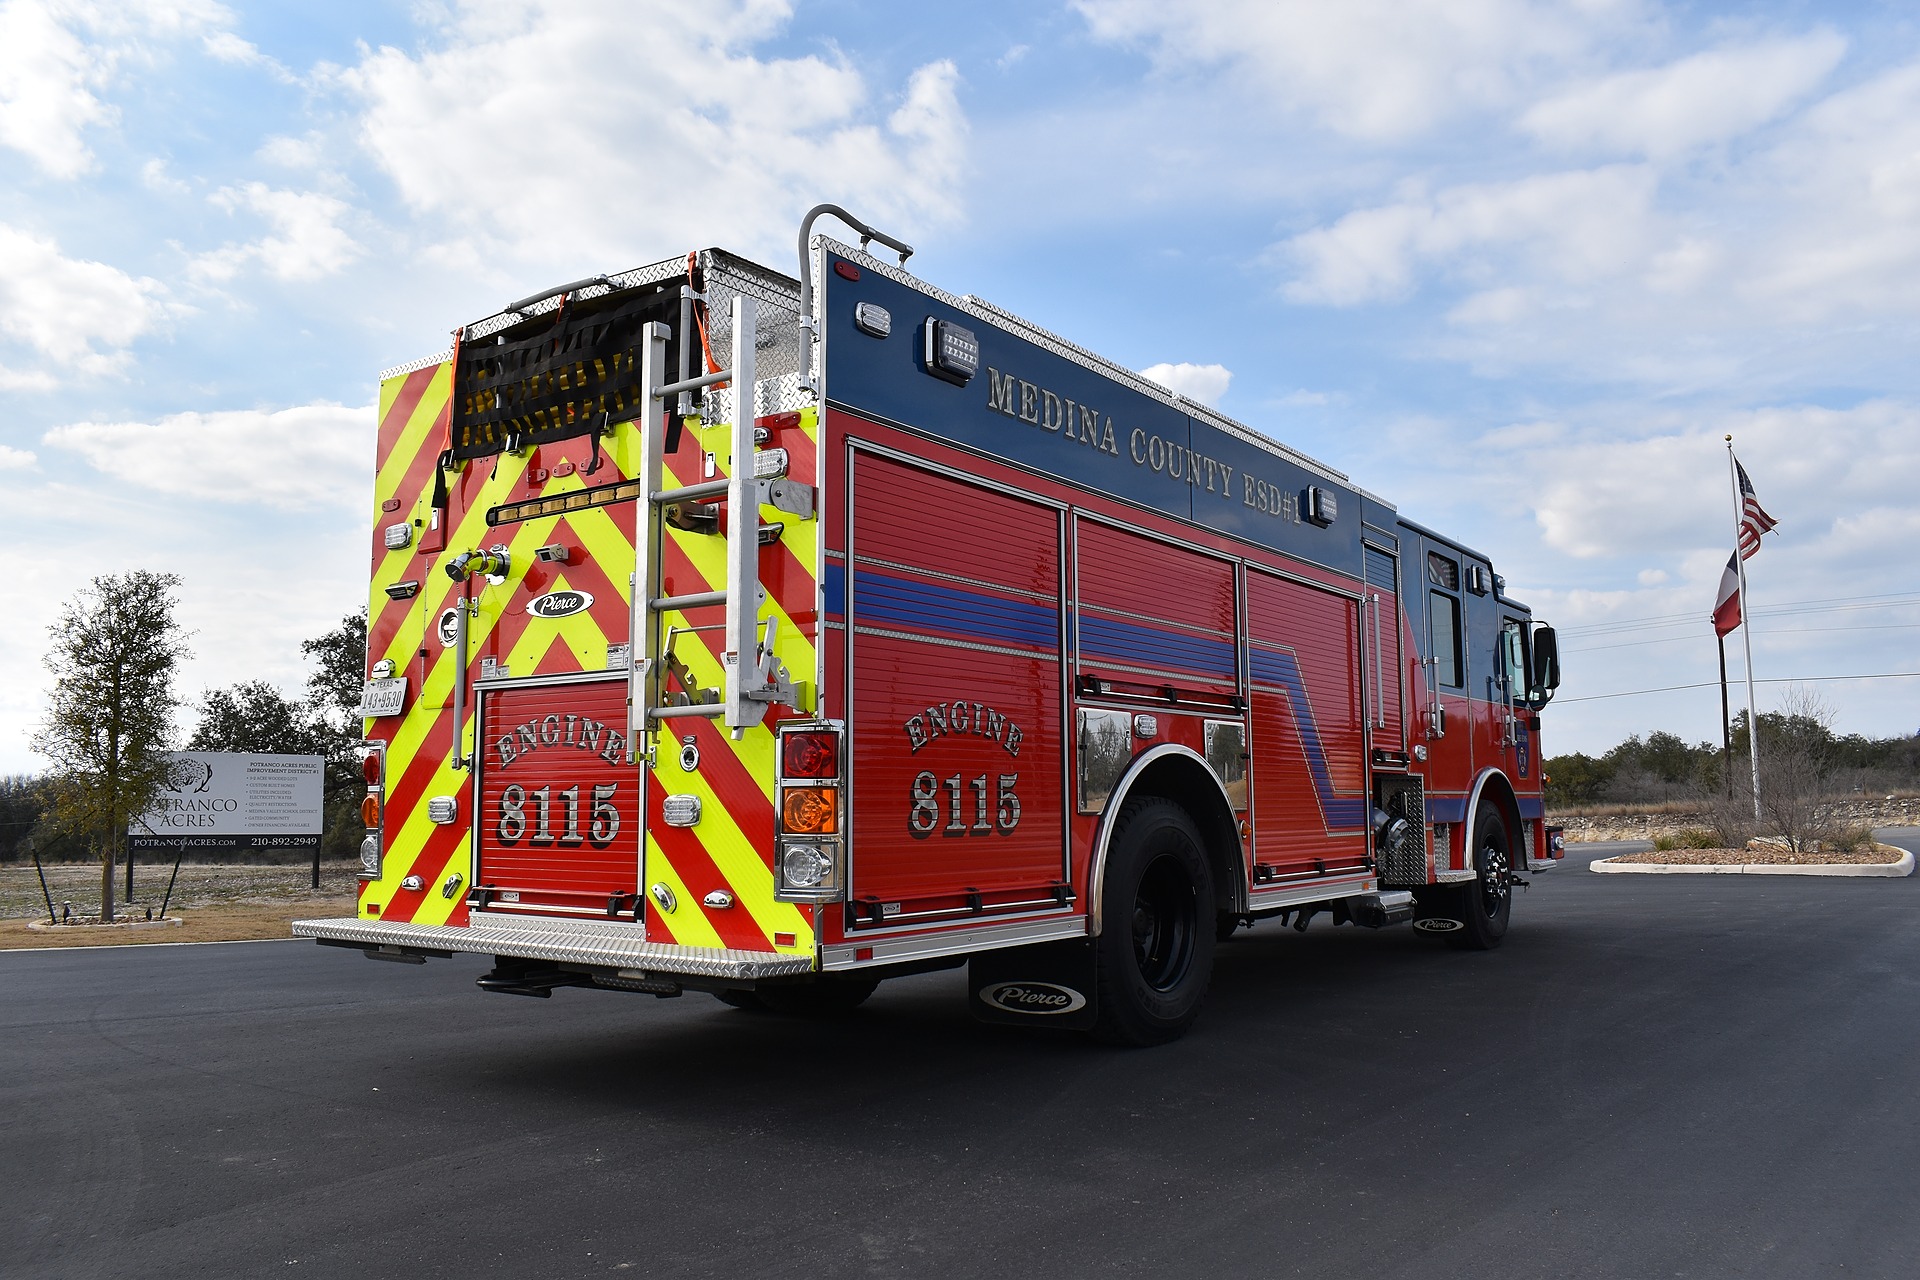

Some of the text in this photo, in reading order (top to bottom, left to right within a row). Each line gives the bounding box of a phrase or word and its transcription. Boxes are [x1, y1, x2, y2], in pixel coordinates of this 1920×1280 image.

[987, 366, 1301, 526] MEDINA COUNTY ESD#1
[539, 595, 578, 615] Pierce
[376, 680, 394, 689] TEXAS
[903, 700, 1024, 757] ENGINE
[495, 714, 627, 770] ENGINE
[909, 770, 1022, 837] 8115
[160, 813, 216, 828] ACRES
[498, 782, 620, 846] 8115
[251, 837, 317, 846] 210-892-2949
[1424, 920, 1452, 929] Pierce
[997, 987, 1068, 1006] Pierce
